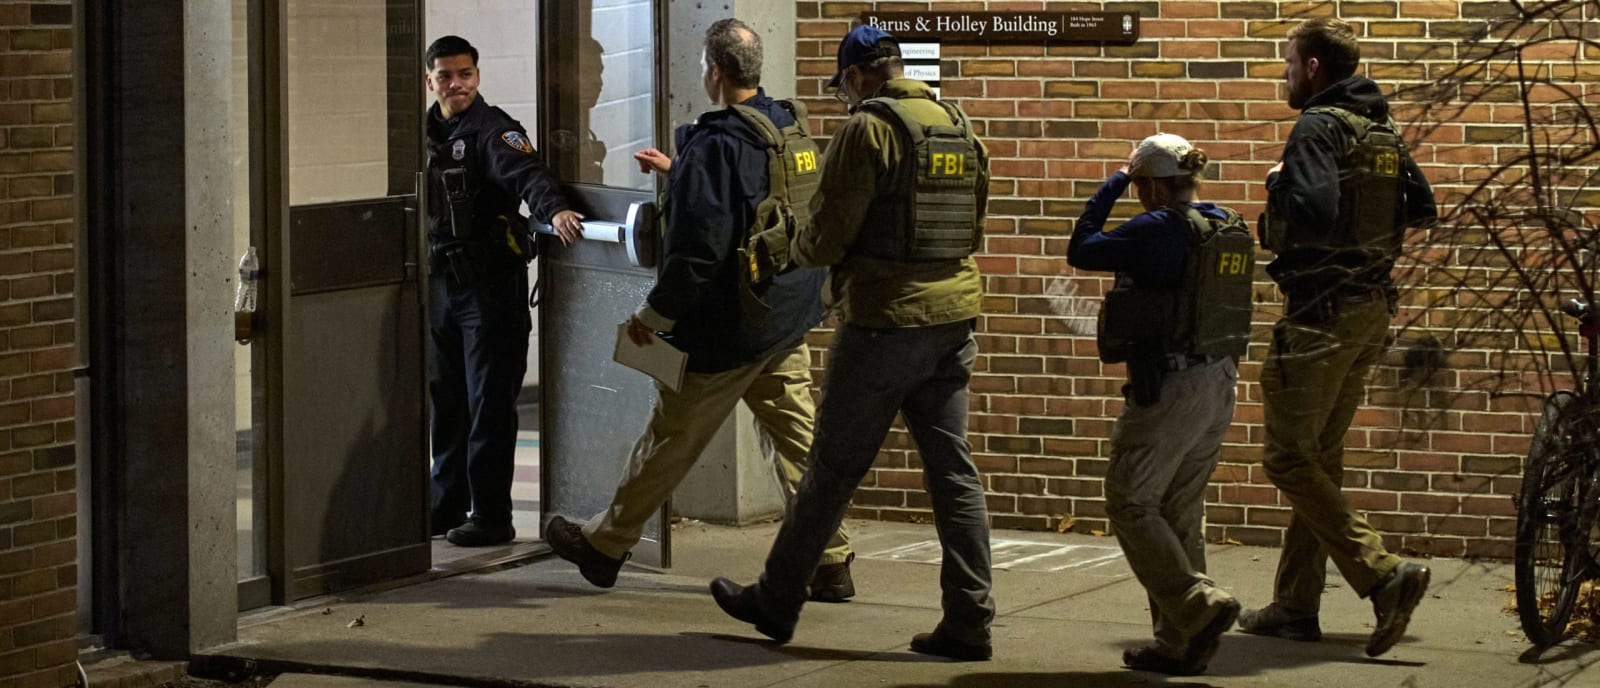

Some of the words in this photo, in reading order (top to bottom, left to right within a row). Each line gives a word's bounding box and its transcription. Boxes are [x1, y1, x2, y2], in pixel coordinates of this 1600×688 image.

[868, 16, 910, 32] Barus
[915, 16, 931, 32] &
[936, 15, 987, 36] Holley
[992, 15, 1058, 36] Building
[902, 47, 935, 55] ngineering
[913, 69, 936, 78] Physics
[795, 150, 817, 172] FBI
[932, 153, 964, 175] FBI
[1376, 152, 1399, 175] FBI
[1219, 252, 1248, 275] FBI
